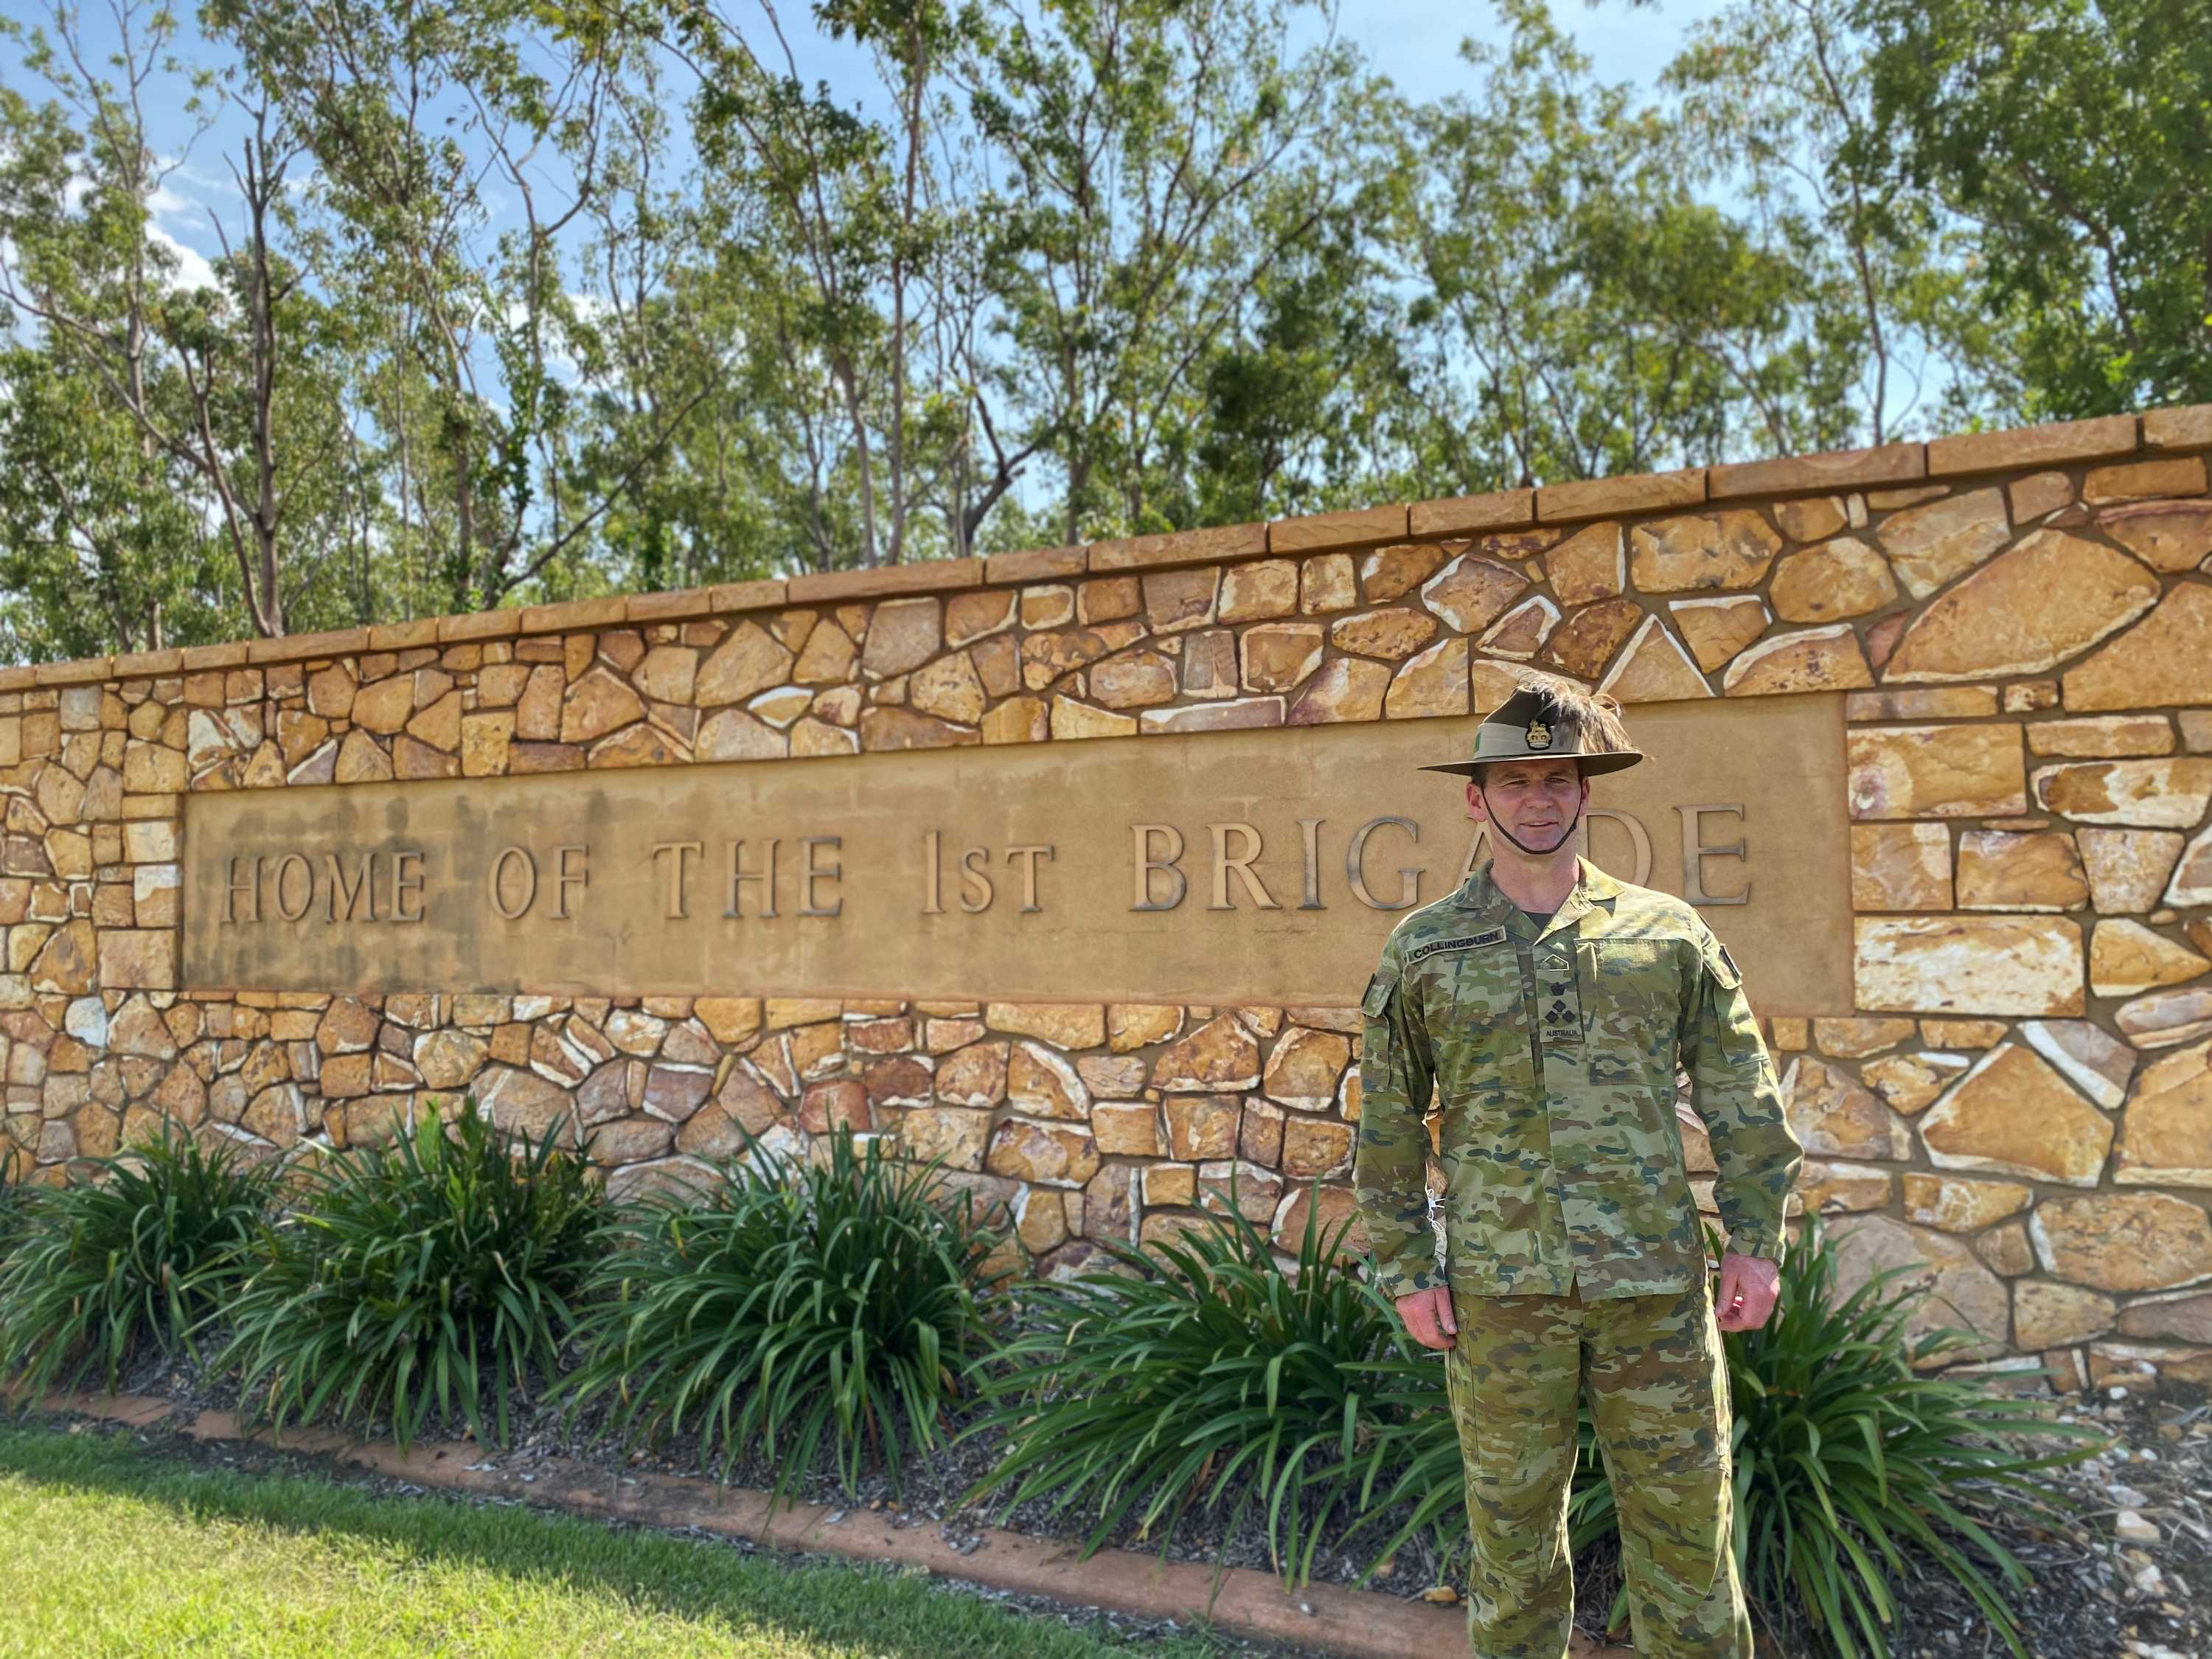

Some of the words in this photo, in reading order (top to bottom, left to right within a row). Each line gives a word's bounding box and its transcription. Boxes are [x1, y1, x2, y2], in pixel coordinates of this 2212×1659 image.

[221, 849, 426, 925] HOME
[488, 845, 591, 919] OF
[653, 835, 844, 919] THE
[1413, 931, 1499, 959] COLLINGBURN
